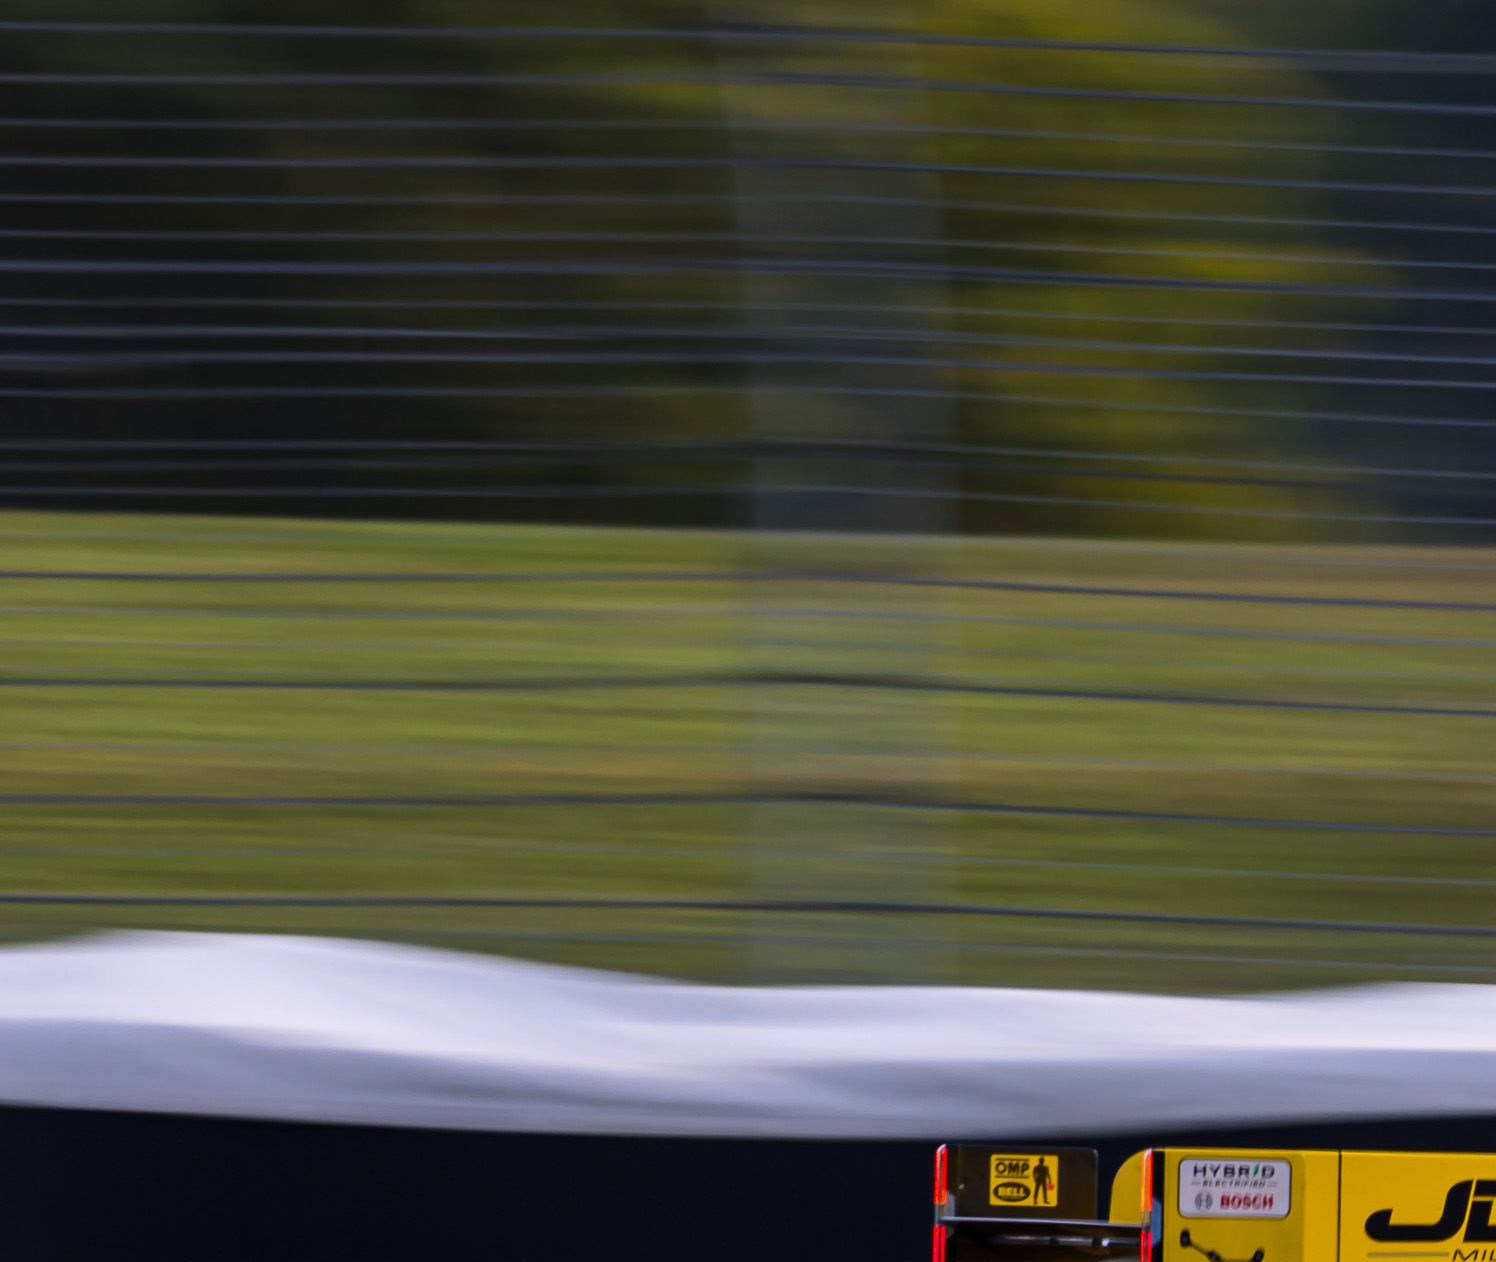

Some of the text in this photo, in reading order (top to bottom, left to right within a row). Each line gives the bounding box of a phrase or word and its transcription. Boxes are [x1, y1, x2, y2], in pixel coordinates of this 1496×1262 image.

[995, 1161, 1030, 1175] OMP
[1193, 1164, 1275, 1179] HYBRID
[997, 1186, 1026, 1197] BELL
[1220, 1193, 1274, 1210] BOSCH
